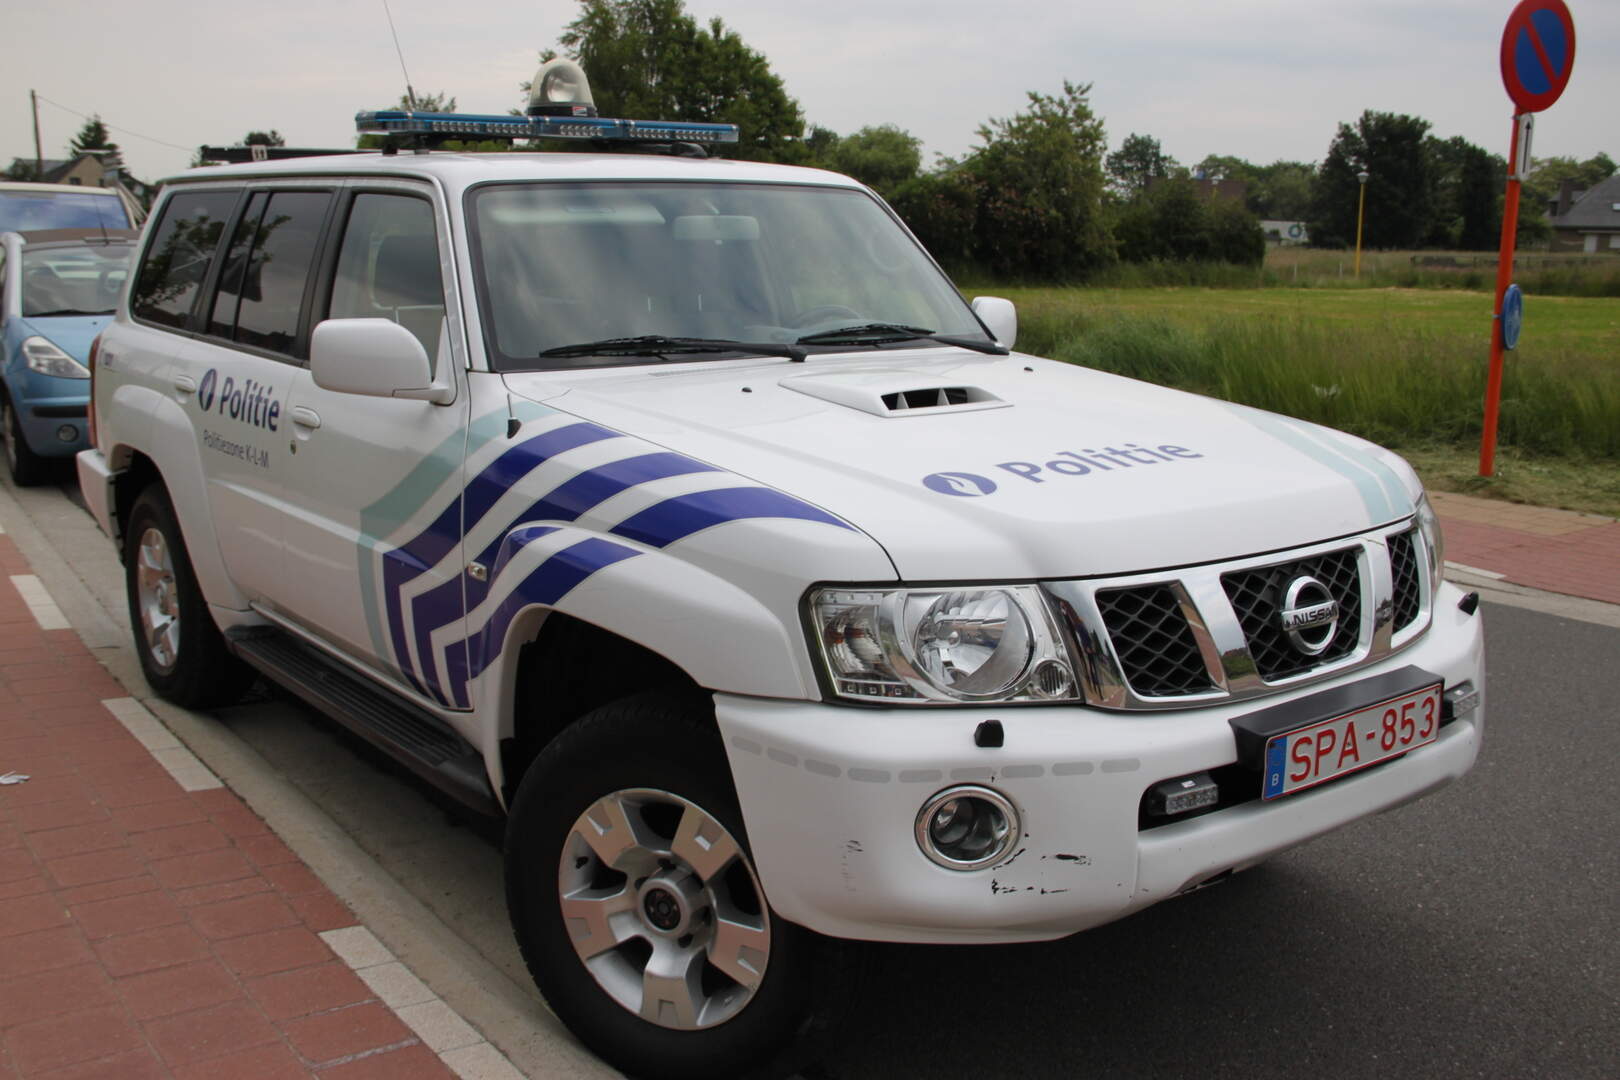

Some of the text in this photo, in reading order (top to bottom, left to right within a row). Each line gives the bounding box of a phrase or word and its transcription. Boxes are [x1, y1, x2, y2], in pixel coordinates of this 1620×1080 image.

[219, 377, 280, 432] Politie
[246, 444, 270, 469] K-L-M
[994, 443, 1204, 483] Politie
[1293, 604, 1337, 625] NISSAN
[1290, 696, 1436, 783] SPA-853
[1271, 772, 1279, 786] B
